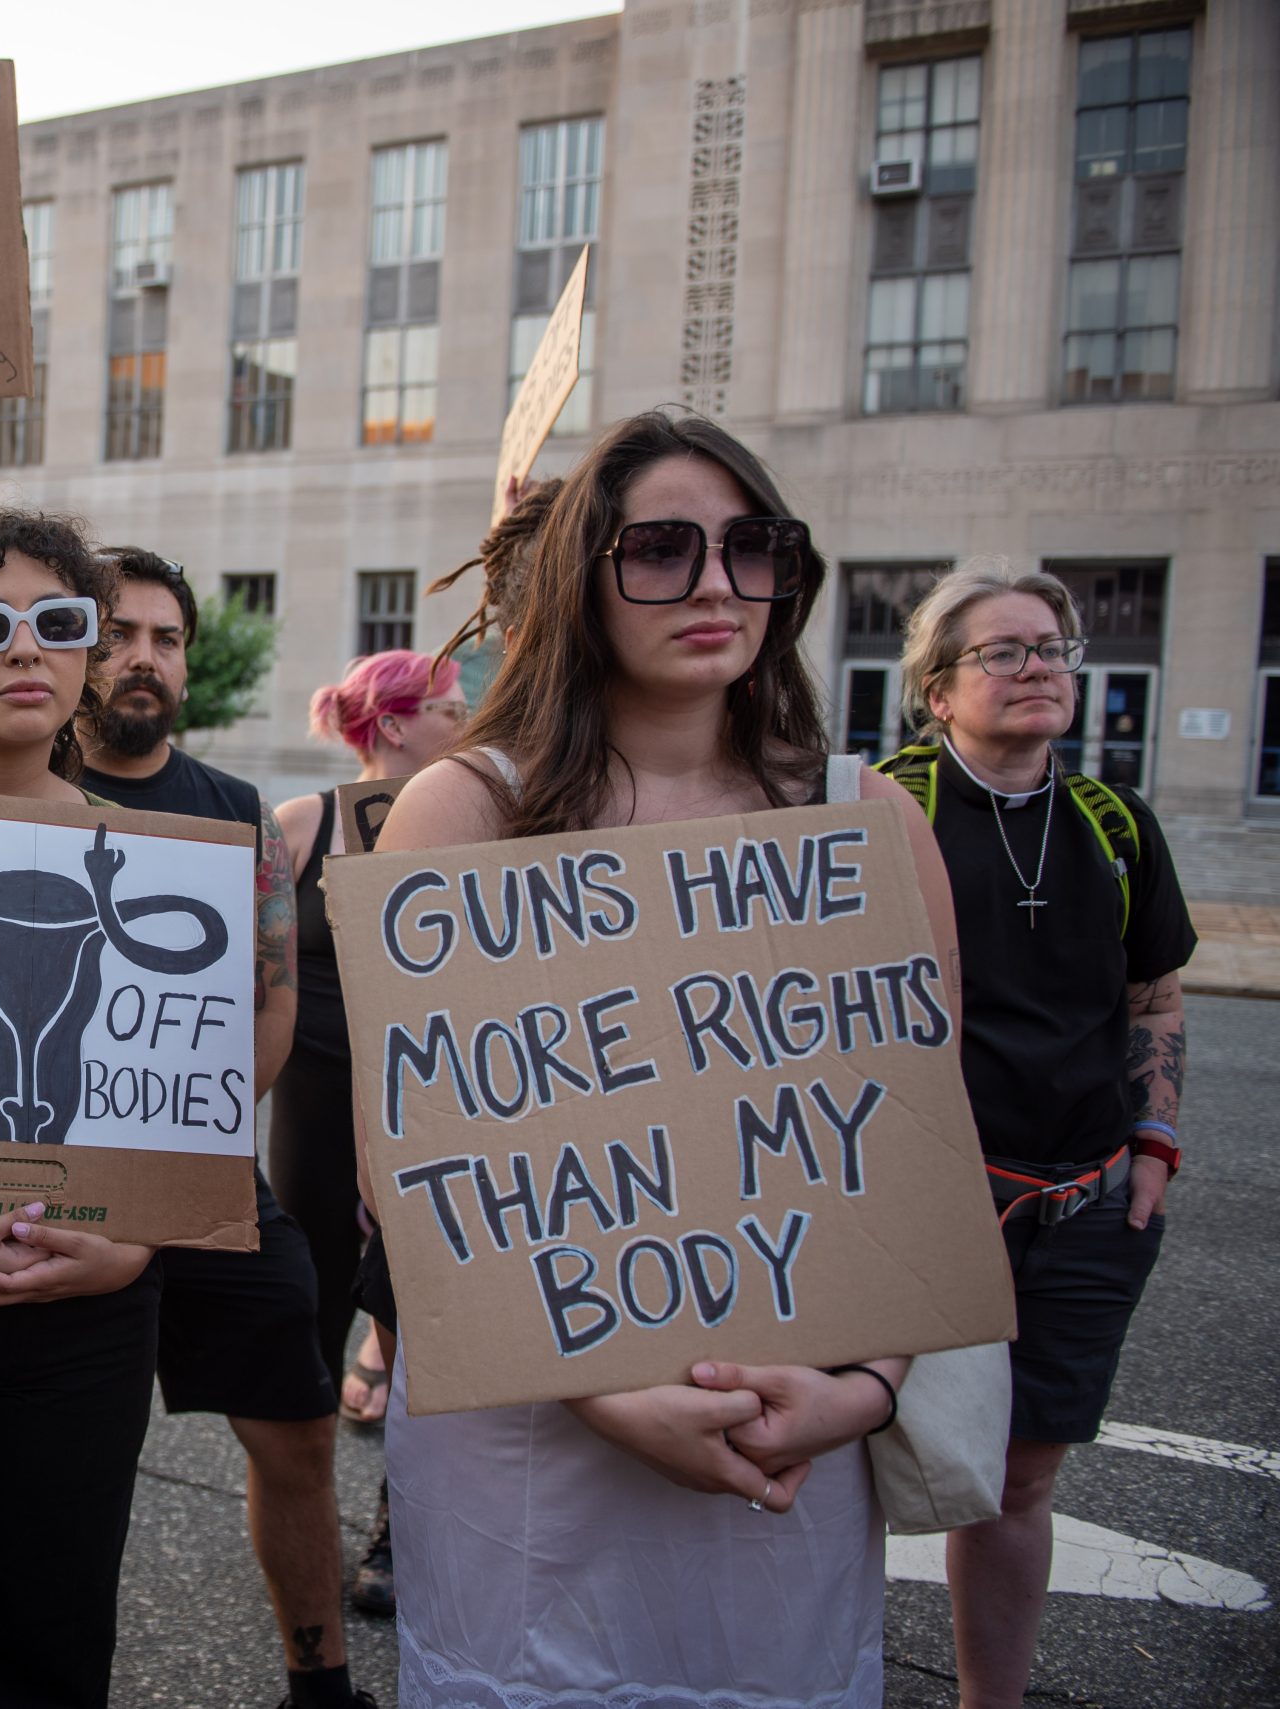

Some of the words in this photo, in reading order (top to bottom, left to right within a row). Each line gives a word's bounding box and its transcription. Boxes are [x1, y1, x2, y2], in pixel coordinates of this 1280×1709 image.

[381, 850, 638, 977] GUNS
[664, 828, 869, 938] HAVE
[106, 984, 236, 1051] OFF
[382, 986, 661, 1140] MORE
[668, 953, 953, 1075] RIGHTS
[83, 1060, 246, 1135] BODIES
[394, 1124, 679, 1265] THAN
[733, 1077, 888, 1200] MY
[530, 1209, 813, 1358] BODY
